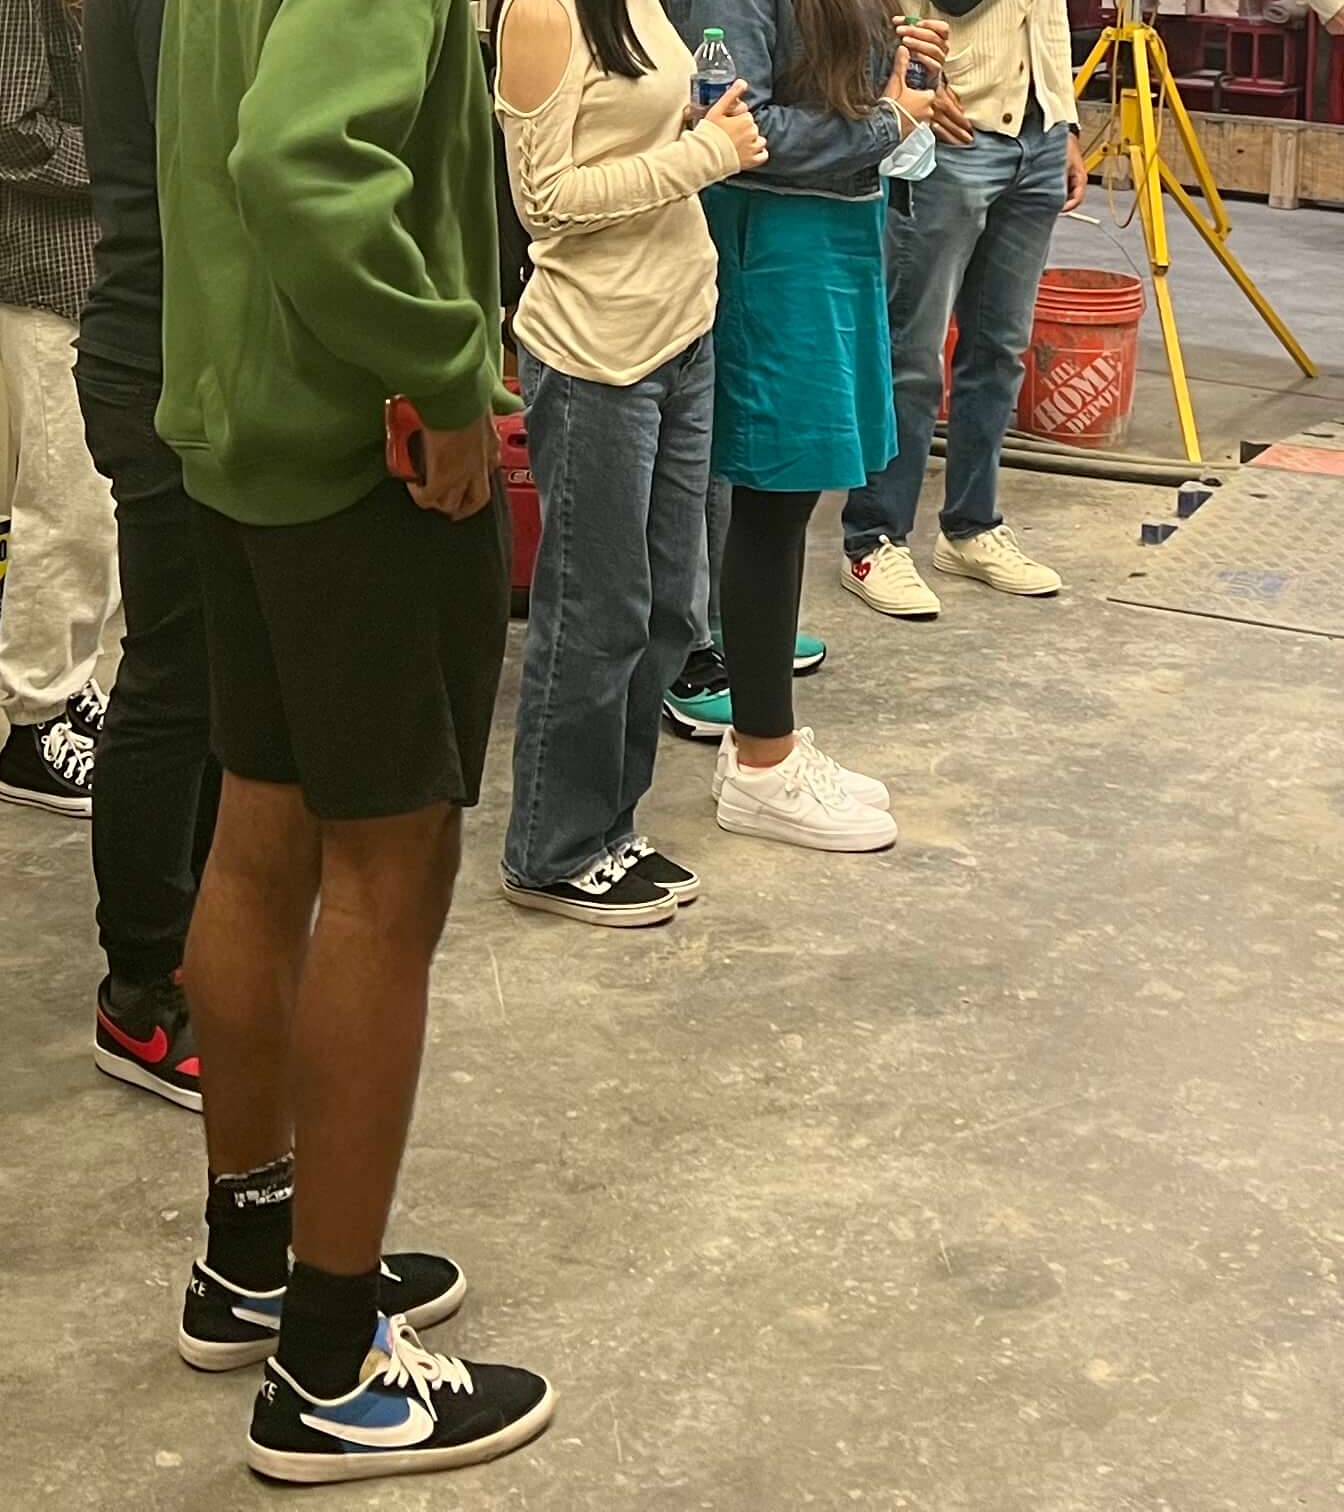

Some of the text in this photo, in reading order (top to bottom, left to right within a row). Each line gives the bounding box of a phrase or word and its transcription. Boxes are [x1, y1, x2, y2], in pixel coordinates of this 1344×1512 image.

[1033, 351, 1122, 432] HOME
[1040, 359, 1081, 389] THE
[1065, 384, 1121, 434] DEPOT
